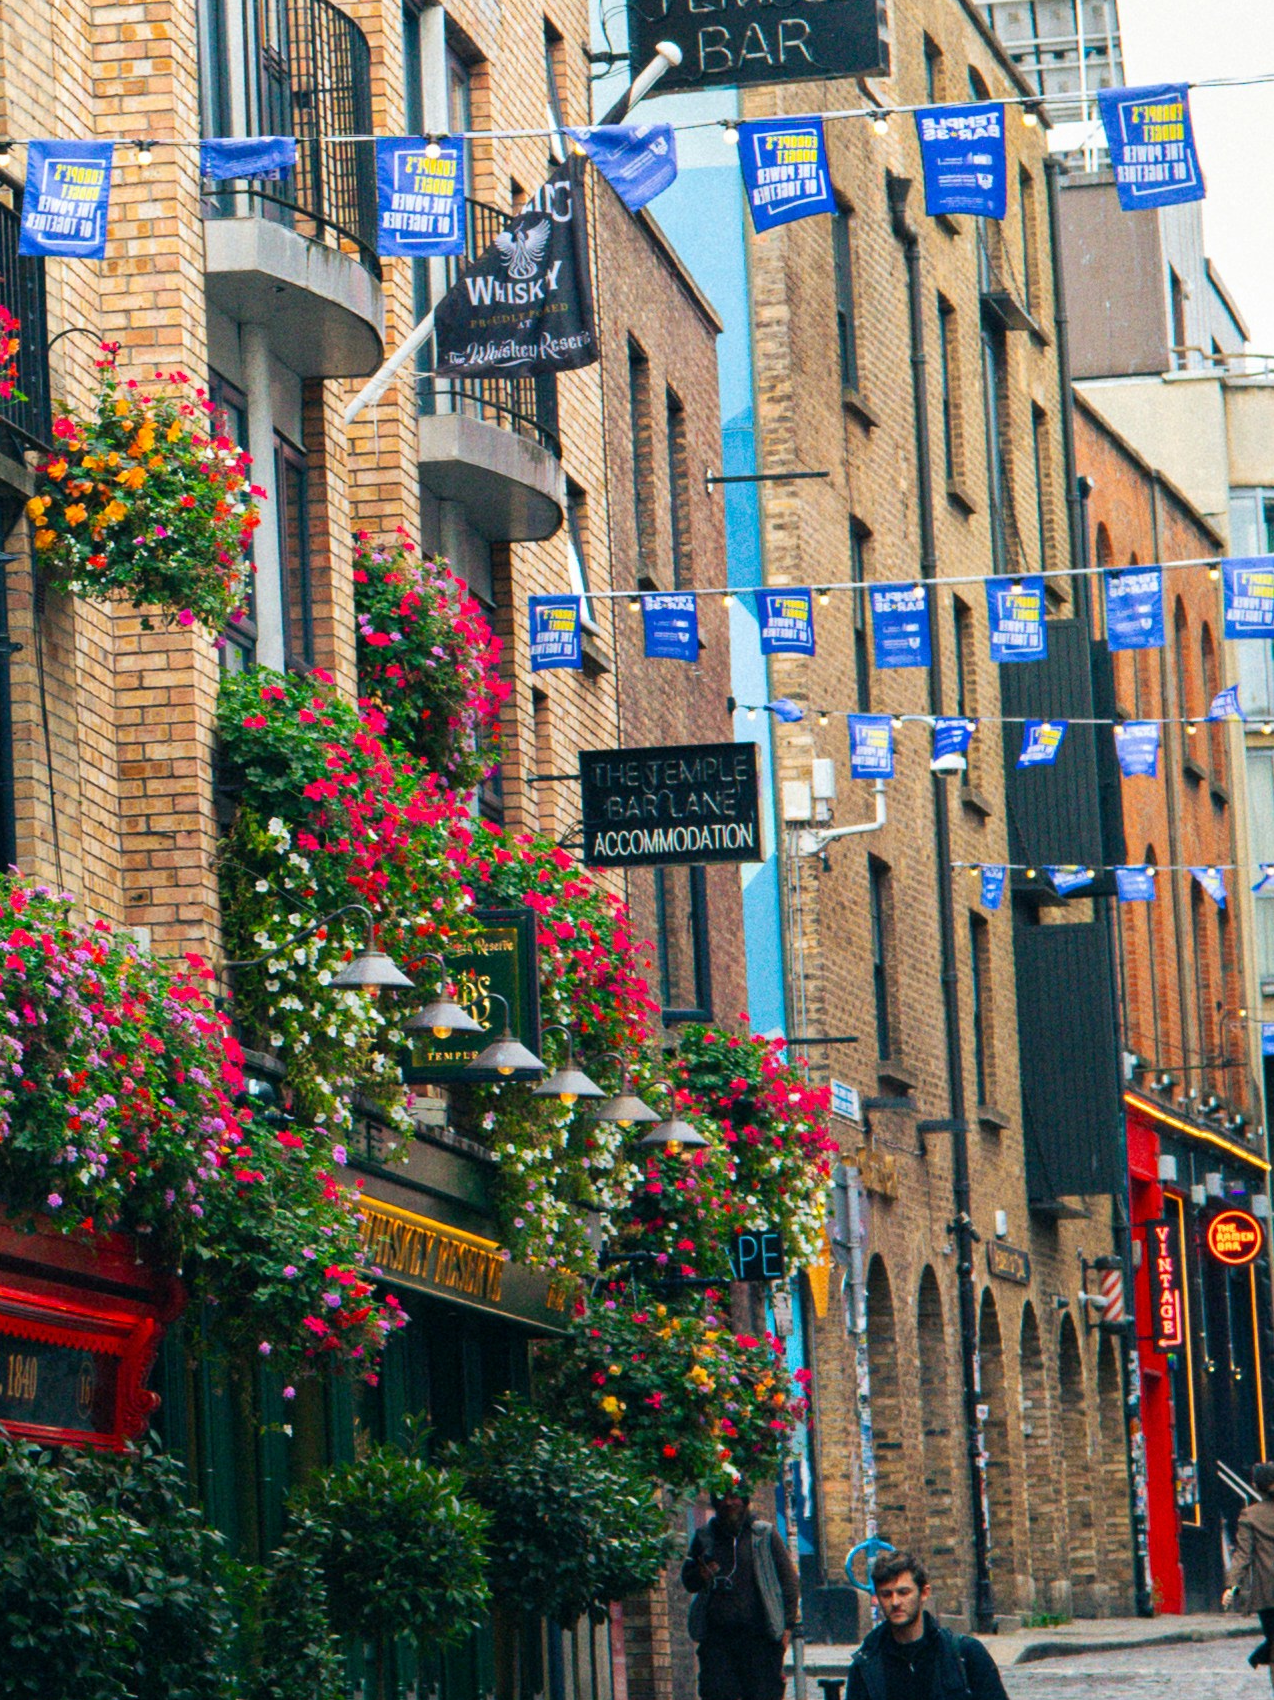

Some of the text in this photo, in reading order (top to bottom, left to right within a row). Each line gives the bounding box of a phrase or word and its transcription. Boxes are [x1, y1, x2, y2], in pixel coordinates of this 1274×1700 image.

[698, 18, 815, 73] BAR
[465, 260, 563, 306] WHISKY
[591, 755, 749, 788] THE TEMPLE
[606, 788, 737, 821] BAR LANE
[594, 823, 754, 857] ACCOMMODATION
[427, 1049, 480, 1062] TEMPLE
[1215, 1222, 1236, 1232] THE
[1215, 1231, 1254, 1242] RAMEN
[435, 1236, 506, 1302] RESERVE
[1155, 1226, 1175, 1334] VINTAGE
[7, 1354, 39, 1401] 1840
